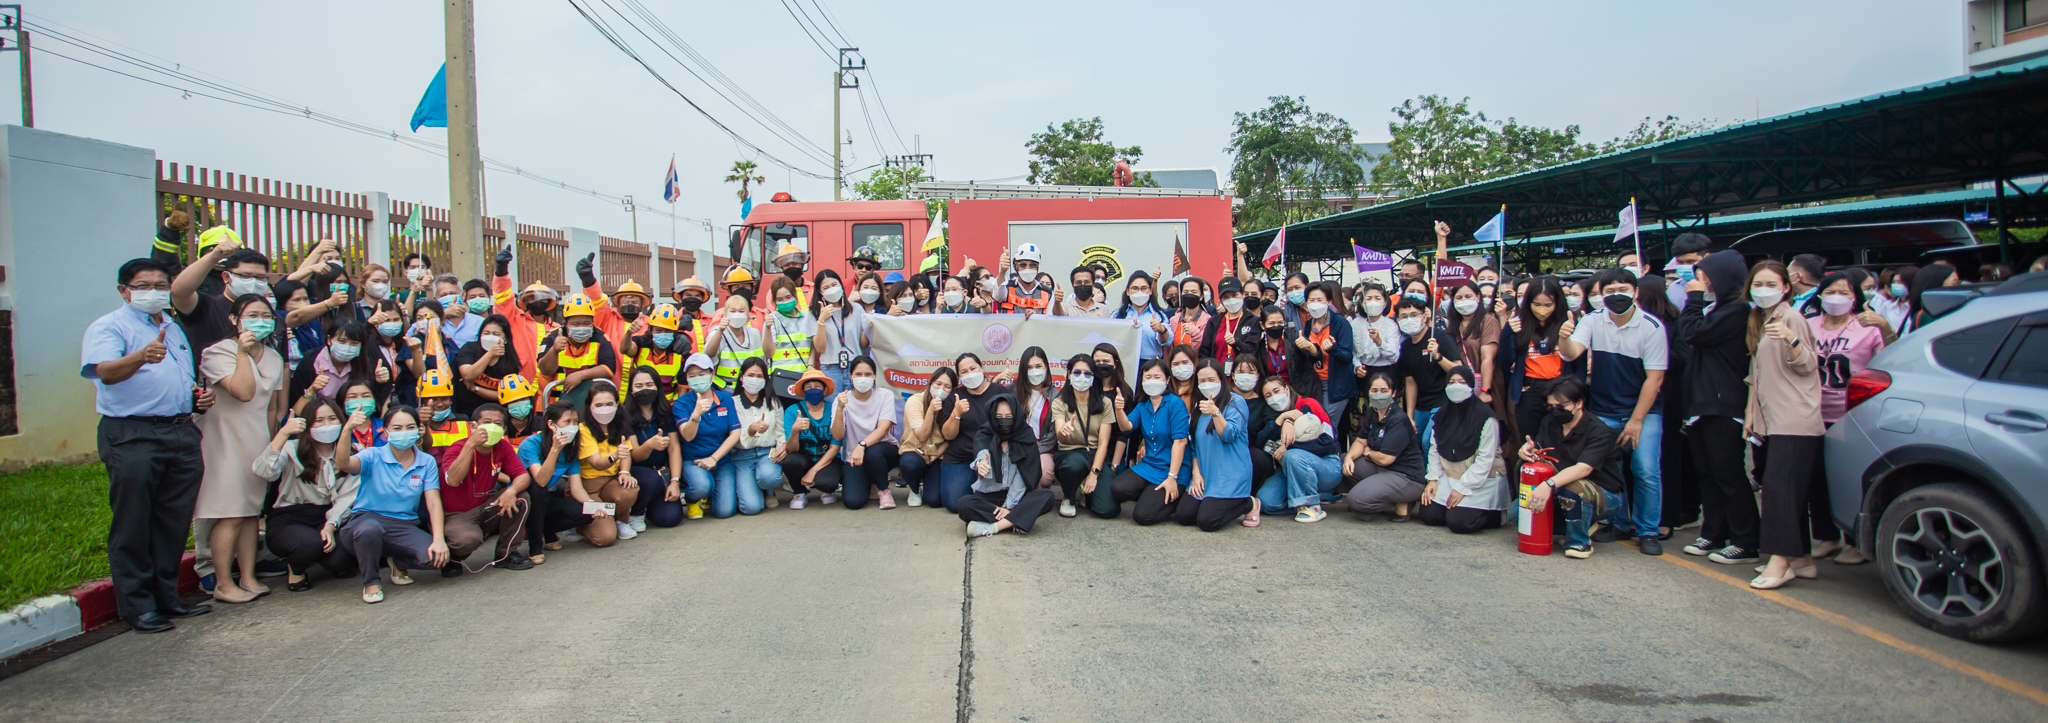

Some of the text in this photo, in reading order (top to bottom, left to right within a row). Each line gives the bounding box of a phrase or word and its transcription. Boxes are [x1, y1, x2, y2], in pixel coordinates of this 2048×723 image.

[1361, 251, 1388, 260] KMITL
[1440, 265, 1465, 275] KMITL
[1816, 336, 1850, 351] MITL
[889, 371, 929, 386] โครงการ
